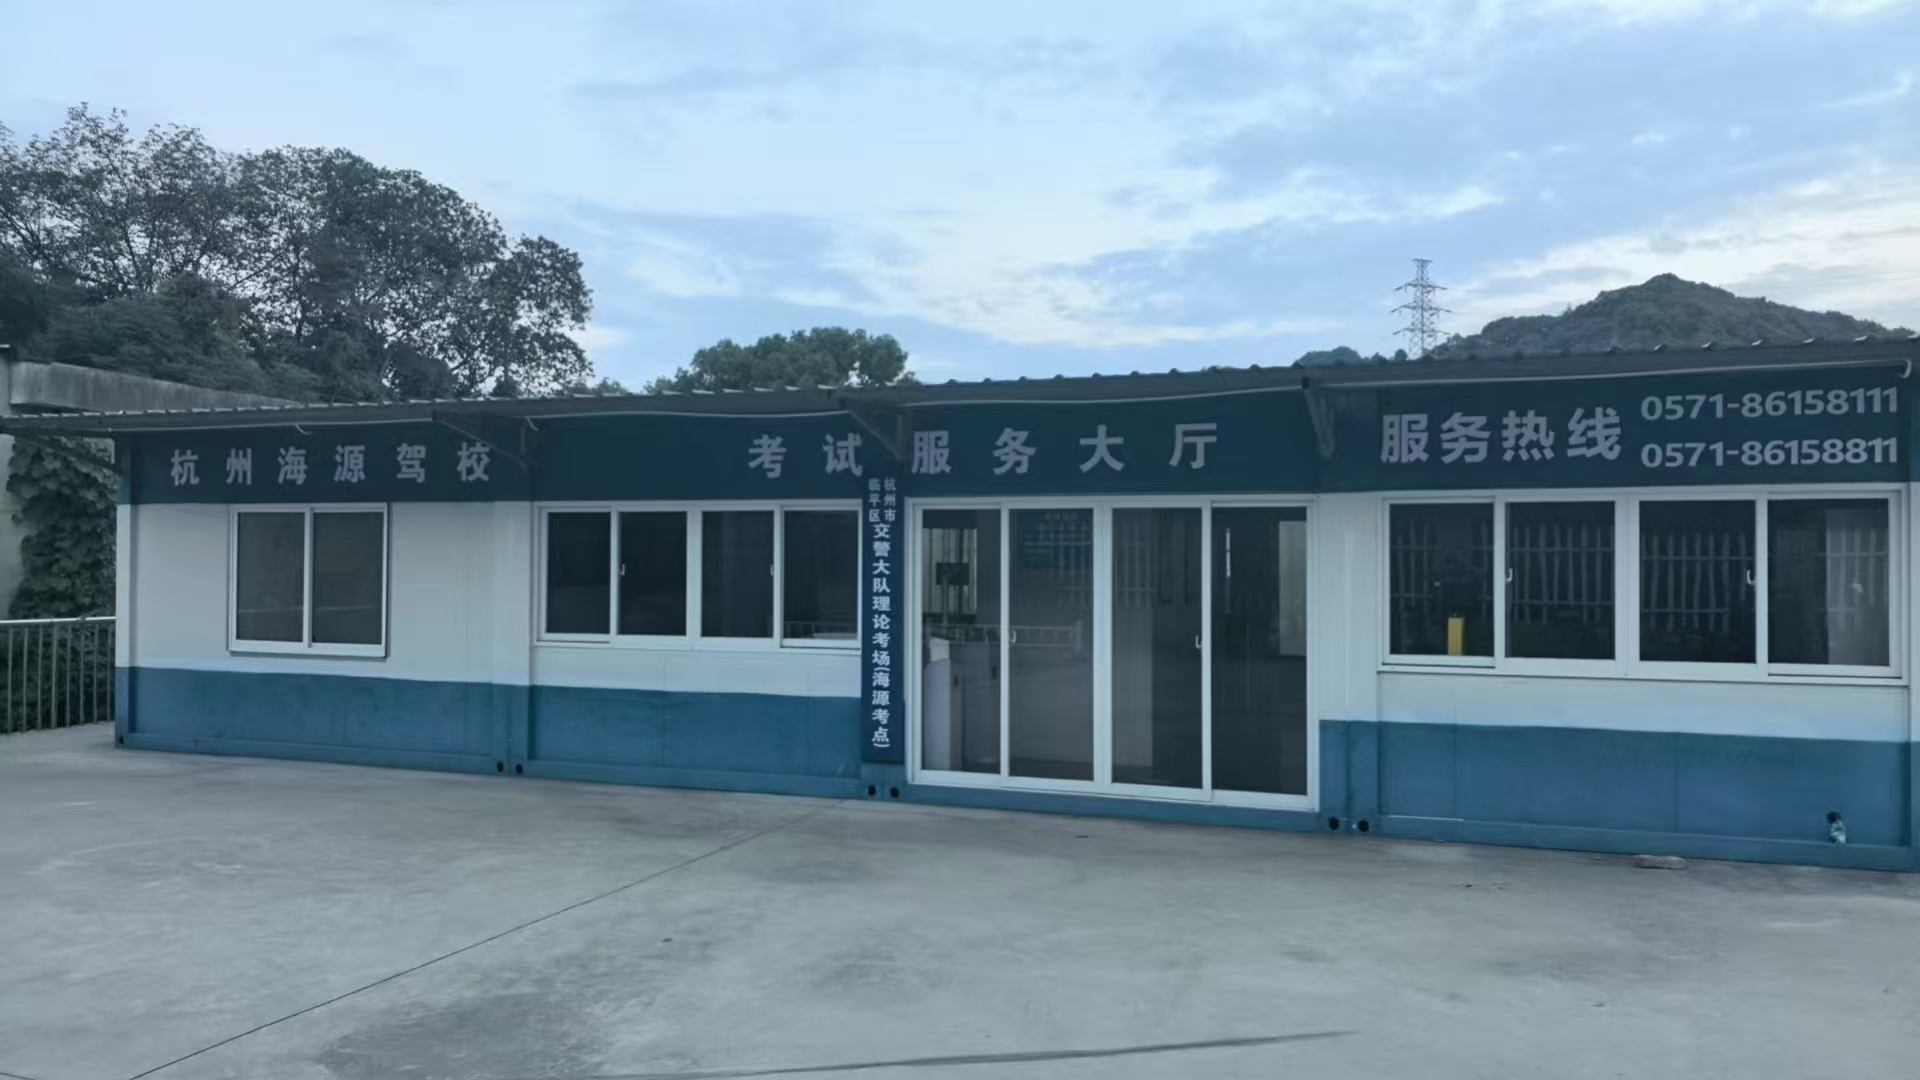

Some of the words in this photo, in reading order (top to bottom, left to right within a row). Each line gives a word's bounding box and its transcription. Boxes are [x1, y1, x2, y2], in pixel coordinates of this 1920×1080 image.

[1640, 387, 1899, 421] 0571-86158111
[748, 422, 1218, 478] 考试服务大厅
[1380, 406, 1622, 464] 服务热线
[1640, 437, 1899, 468] 0571-86158811
[171, 442, 491, 486] 杭州海源驾校
[868, 477, 881, 522] 临平区
[883, 477, 897, 522] 杭州市
